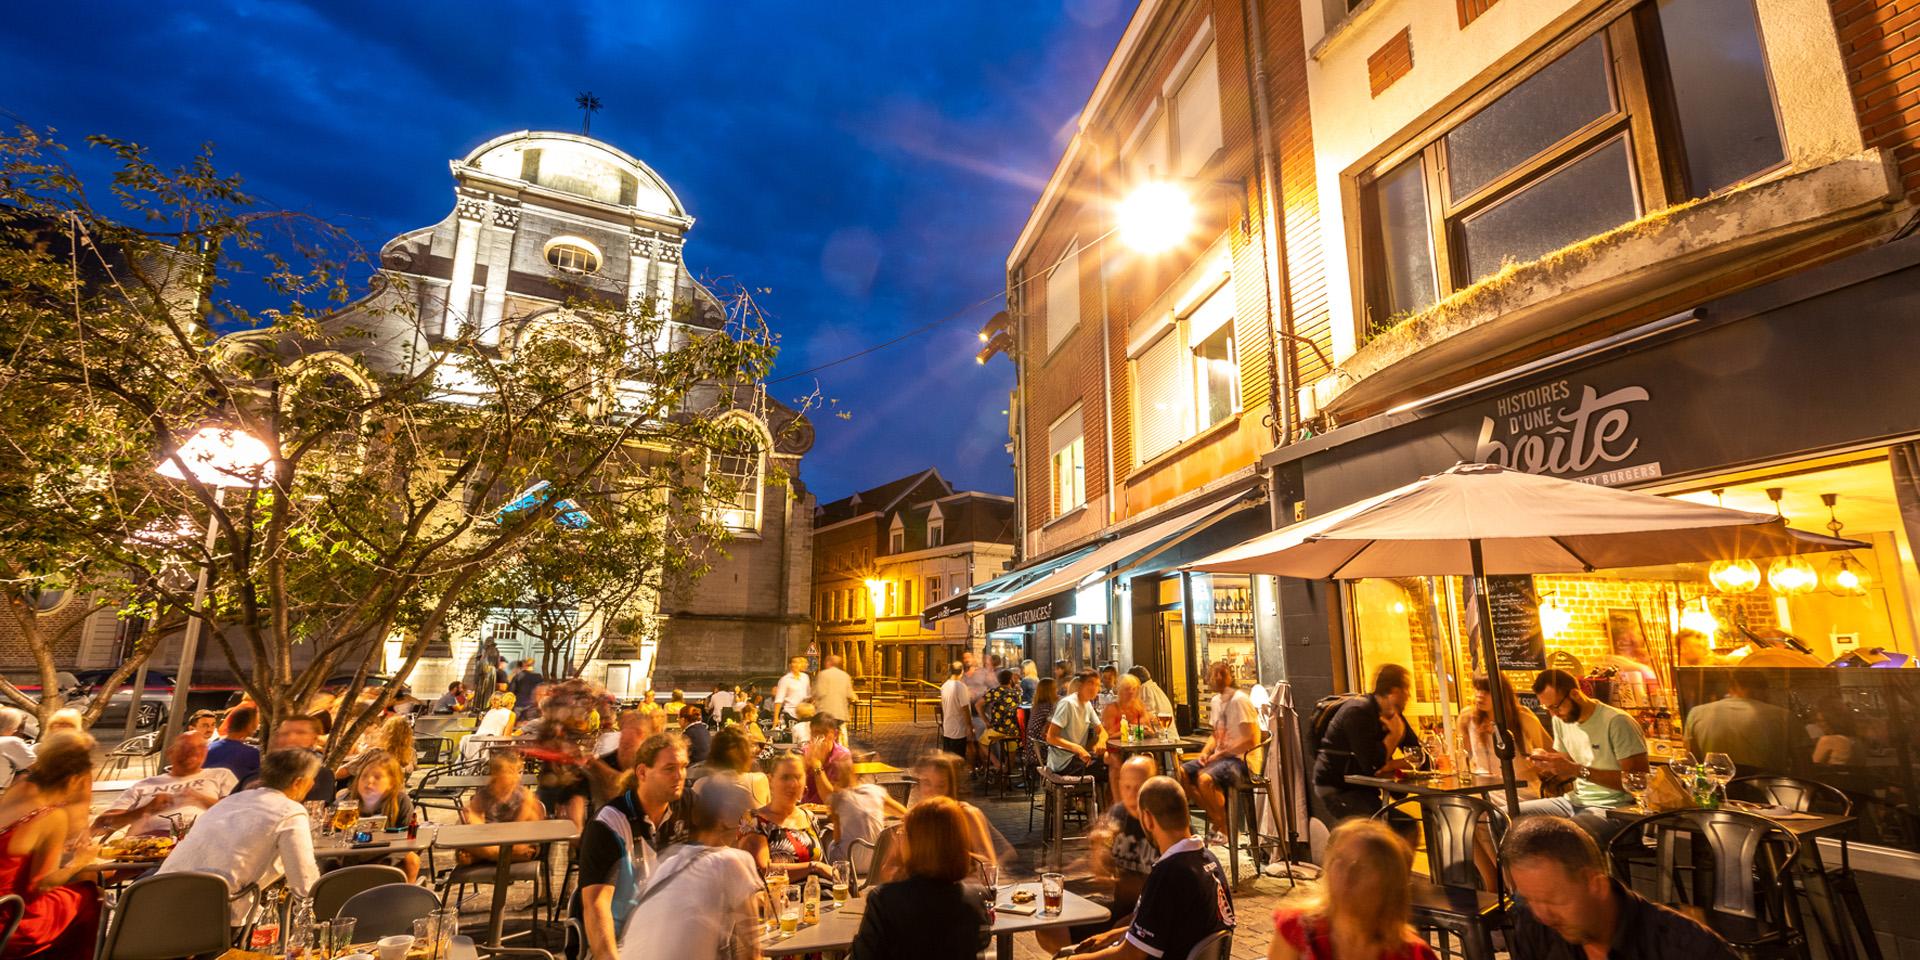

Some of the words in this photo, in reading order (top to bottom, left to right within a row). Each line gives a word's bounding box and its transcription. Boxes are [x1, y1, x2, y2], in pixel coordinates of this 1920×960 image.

[1497, 380, 1570, 416] HISTOIRES
[1474, 385, 1650, 475] boîte
[1509, 407, 1554, 435] D'UNE
[1602, 465, 1656, 485] BURGERS
